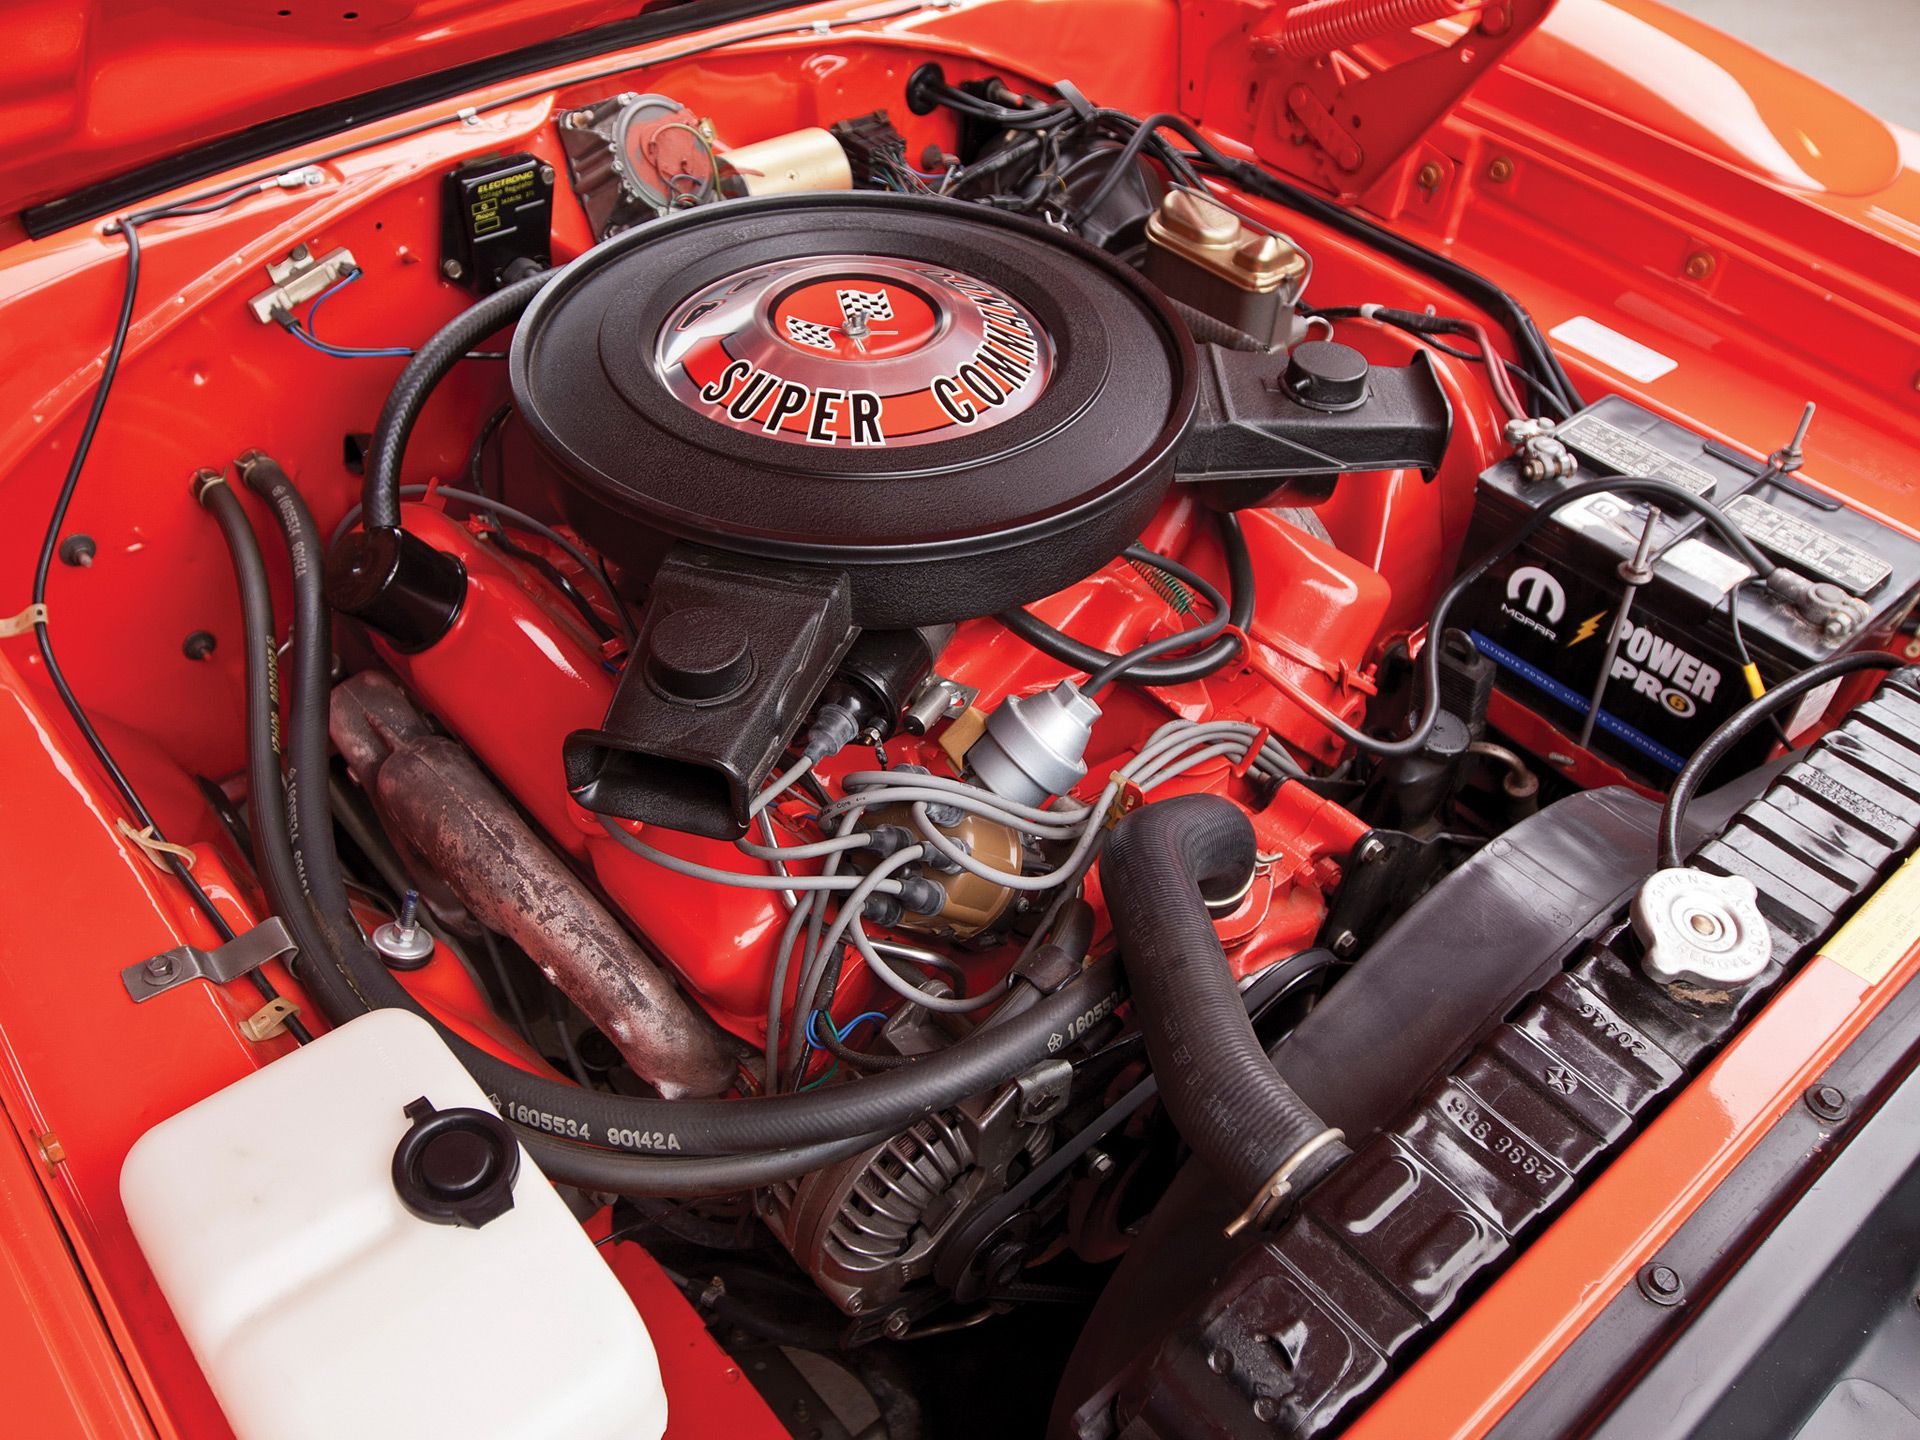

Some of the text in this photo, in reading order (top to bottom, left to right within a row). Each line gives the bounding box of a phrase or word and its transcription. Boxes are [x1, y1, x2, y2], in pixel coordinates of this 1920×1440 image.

[478, 171, 533, 193] ELECTRONIC
[700, 359, 887, 446] SUPER
[1501, 602, 1557, 640] MOPAR
[1480, 640, 1521, 668] ULTIMATE
[1611, 721, 1682, 768] PERFORMANCE
[1576, 1003, 1647, 1058] 20446
[508, 1101, 681, 1150] 1605534 90142A
